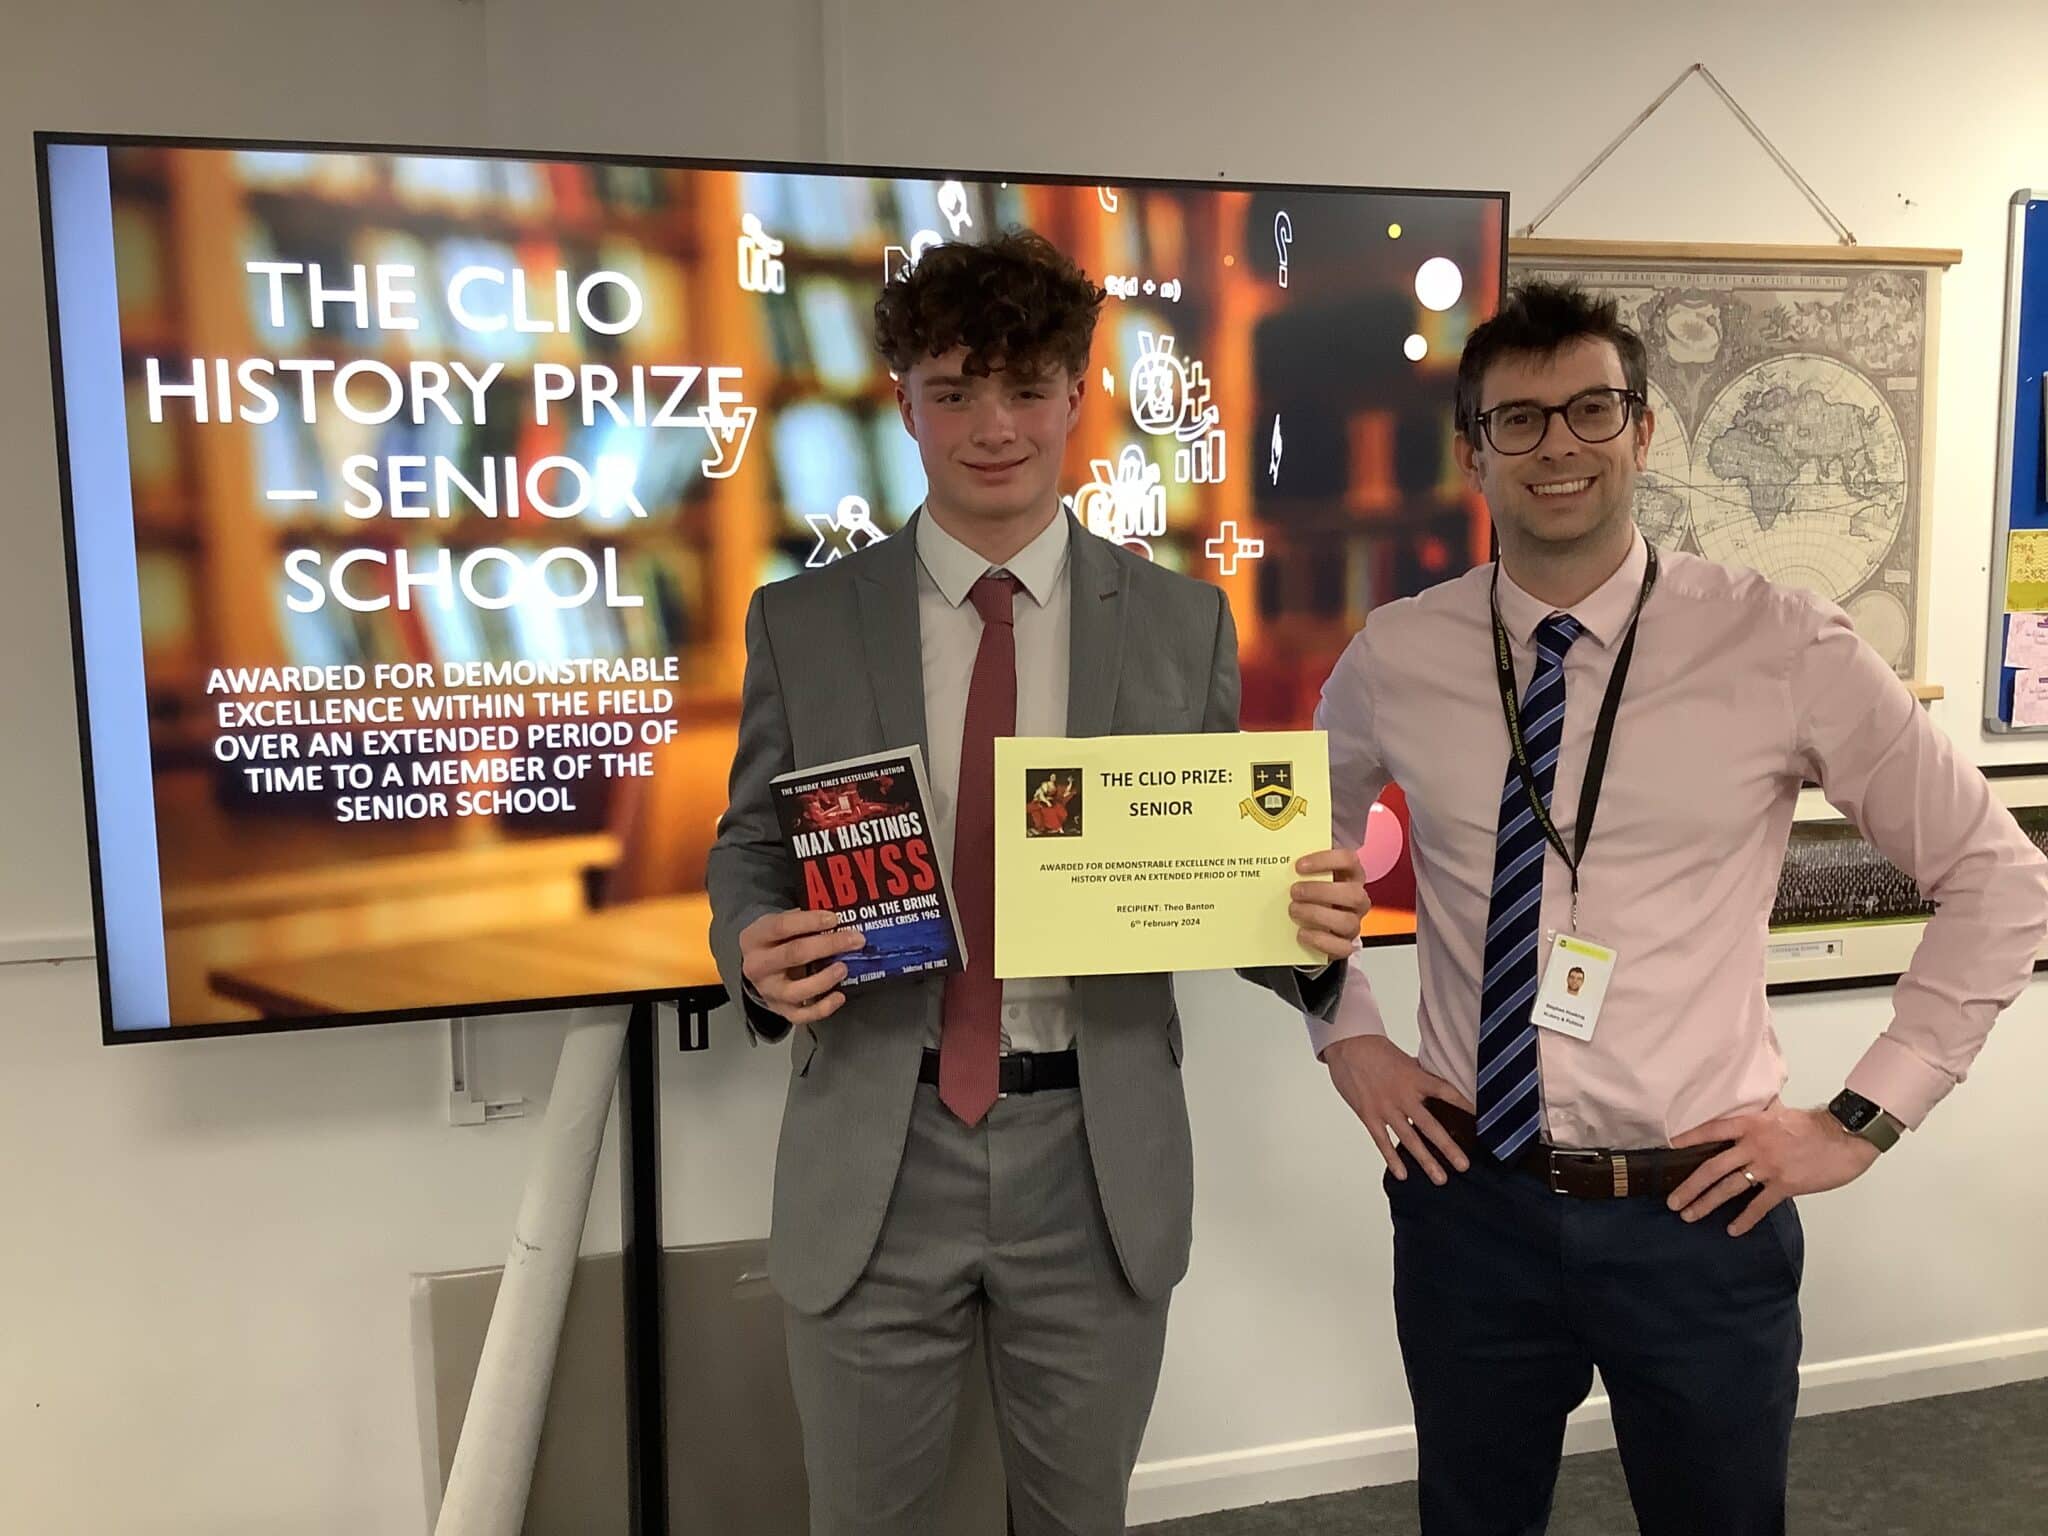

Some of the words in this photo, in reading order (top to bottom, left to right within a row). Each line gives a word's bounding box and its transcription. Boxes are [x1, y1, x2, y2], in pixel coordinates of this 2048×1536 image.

[246, 261, 419, 330] THE
[447, 265, 643, 336] CLIO
[145, 357, 505, 427] HISTORY
[534, 364, 746, 429] PRIZE
[343, 454, 648, 519] SENIOR
[284, 546, 644, 614] SCHOOL
[206, 665, 366, 695] AWARDED
[373, 661, 434, 690] FOR
[443, 655, 680, 689] DEMONSTRABLE
[217, 696, 404, 728] EXCELLENCE
[411, 692, 526, 722] WITHIN
[532, 690, 589, 717] THE
[598, 687, 673, 715] FIELD
[1506, 688, 1517, 722] SCHOOL
[214, 732, 299, 763] OVER
[308, 729, 354, 758] AN
[362, 725, 520, 756] EXTENDED
[527, 722, 632, 751] PERIOD
[639, 719, 679, 747] OF
[244, 766, 324, 794] TIME
[330, 762, 373, 790] TO
[380, 761, 404, 787] A
[411, 755, 546, 786] MEMBER
[552, 753, 592, 780] OF
[599, 752, 654, 778] THE
[781, 788, 794, 797] THE
[795, 782, 819, 794] SUNDAY
[820, 778, 839, 789] TIMES
[840, 770, 879, 785] BESTSELLING
[880, 765, 905, 776] AUTHOR
[1100, 772, 1133, 787] THE
[1138, 770, 1176, 786] CLIO
[1181, 769, 1233, 785] PRIZE:
[336, 791, 448, 823] SENIOR
[456, 787, 575, 818] SCHOOL
[1129, 801, 1193, 817] SENIOR
[792, 829, 834, 859] MAX
[837, 811, 923, 850] HASTINGS
[803, 839, 935, 910] ABYSS
[1039, 862, 1084, 872] AWARDED
[1086, 861, 1103, 871] FOR
[1105, 859, 1173, 870] DEMONSTRABLE
[1175, 858, 1225, 868] EXCELLENCE
[1227, 857, 1236, 866] IN
[1238, 857, 1253, 866] THE
[1255, 856, 1279, 866] FIELD
[1280, 855, 1291, 865] OF
[1071, 875, 1107, 884] HISTORY
[1109, 874, 1132, 883] OVER
[1134, 873, 1147, 882] AN
[1148, 872, 1192, 882] EXTENDED
[1194, 871, 1225, 881] PERIOD
[1227, 870, 1239, 879] OF
[1240, 869, 1261, 878] TIME
[860, 905, 877, 919] ON
[879, 900, 901, 916] THE
[903, 893, 939, 911] BRINK
[865, 918, 894, 931] MISSILE
[895, 913, 919, 925] CRISIS
[921, 909, 941, 920] 1962
[1116, 904, 1162, 913] RECIPIENT:
[1164, 903, 1184, 912] Theo
[1186, 901, 1215, 911] Banton
[1143, 918, 1179, 930] February
[1180, 917, 1200, 927] 2024
